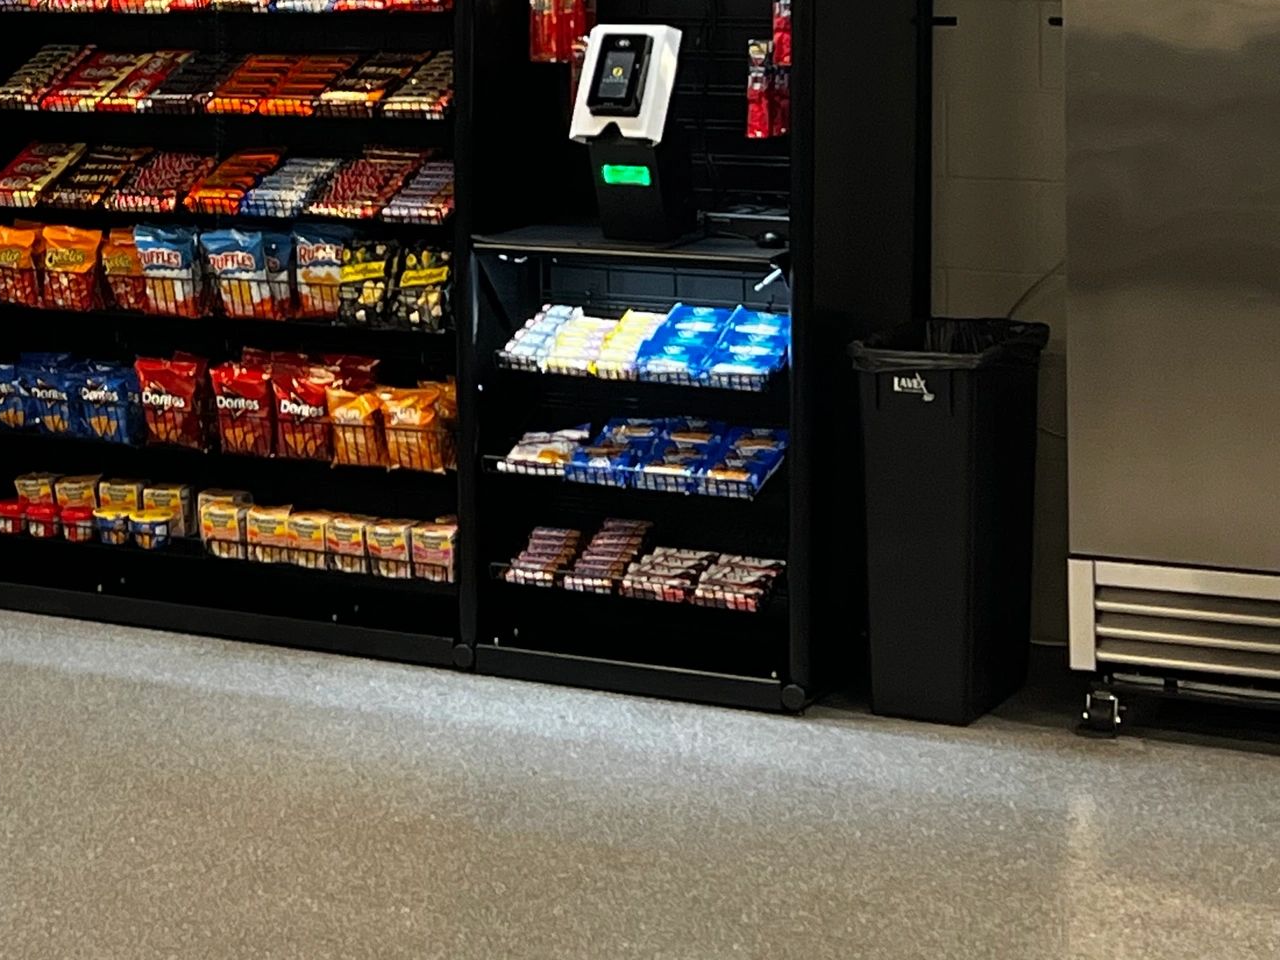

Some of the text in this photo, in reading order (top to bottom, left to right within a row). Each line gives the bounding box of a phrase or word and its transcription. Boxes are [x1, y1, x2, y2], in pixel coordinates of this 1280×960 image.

[141, 390, 186, 408] Doritos
[216, 395, 260, 411] Doritos
[280, 399, 325, 417] Doritos
